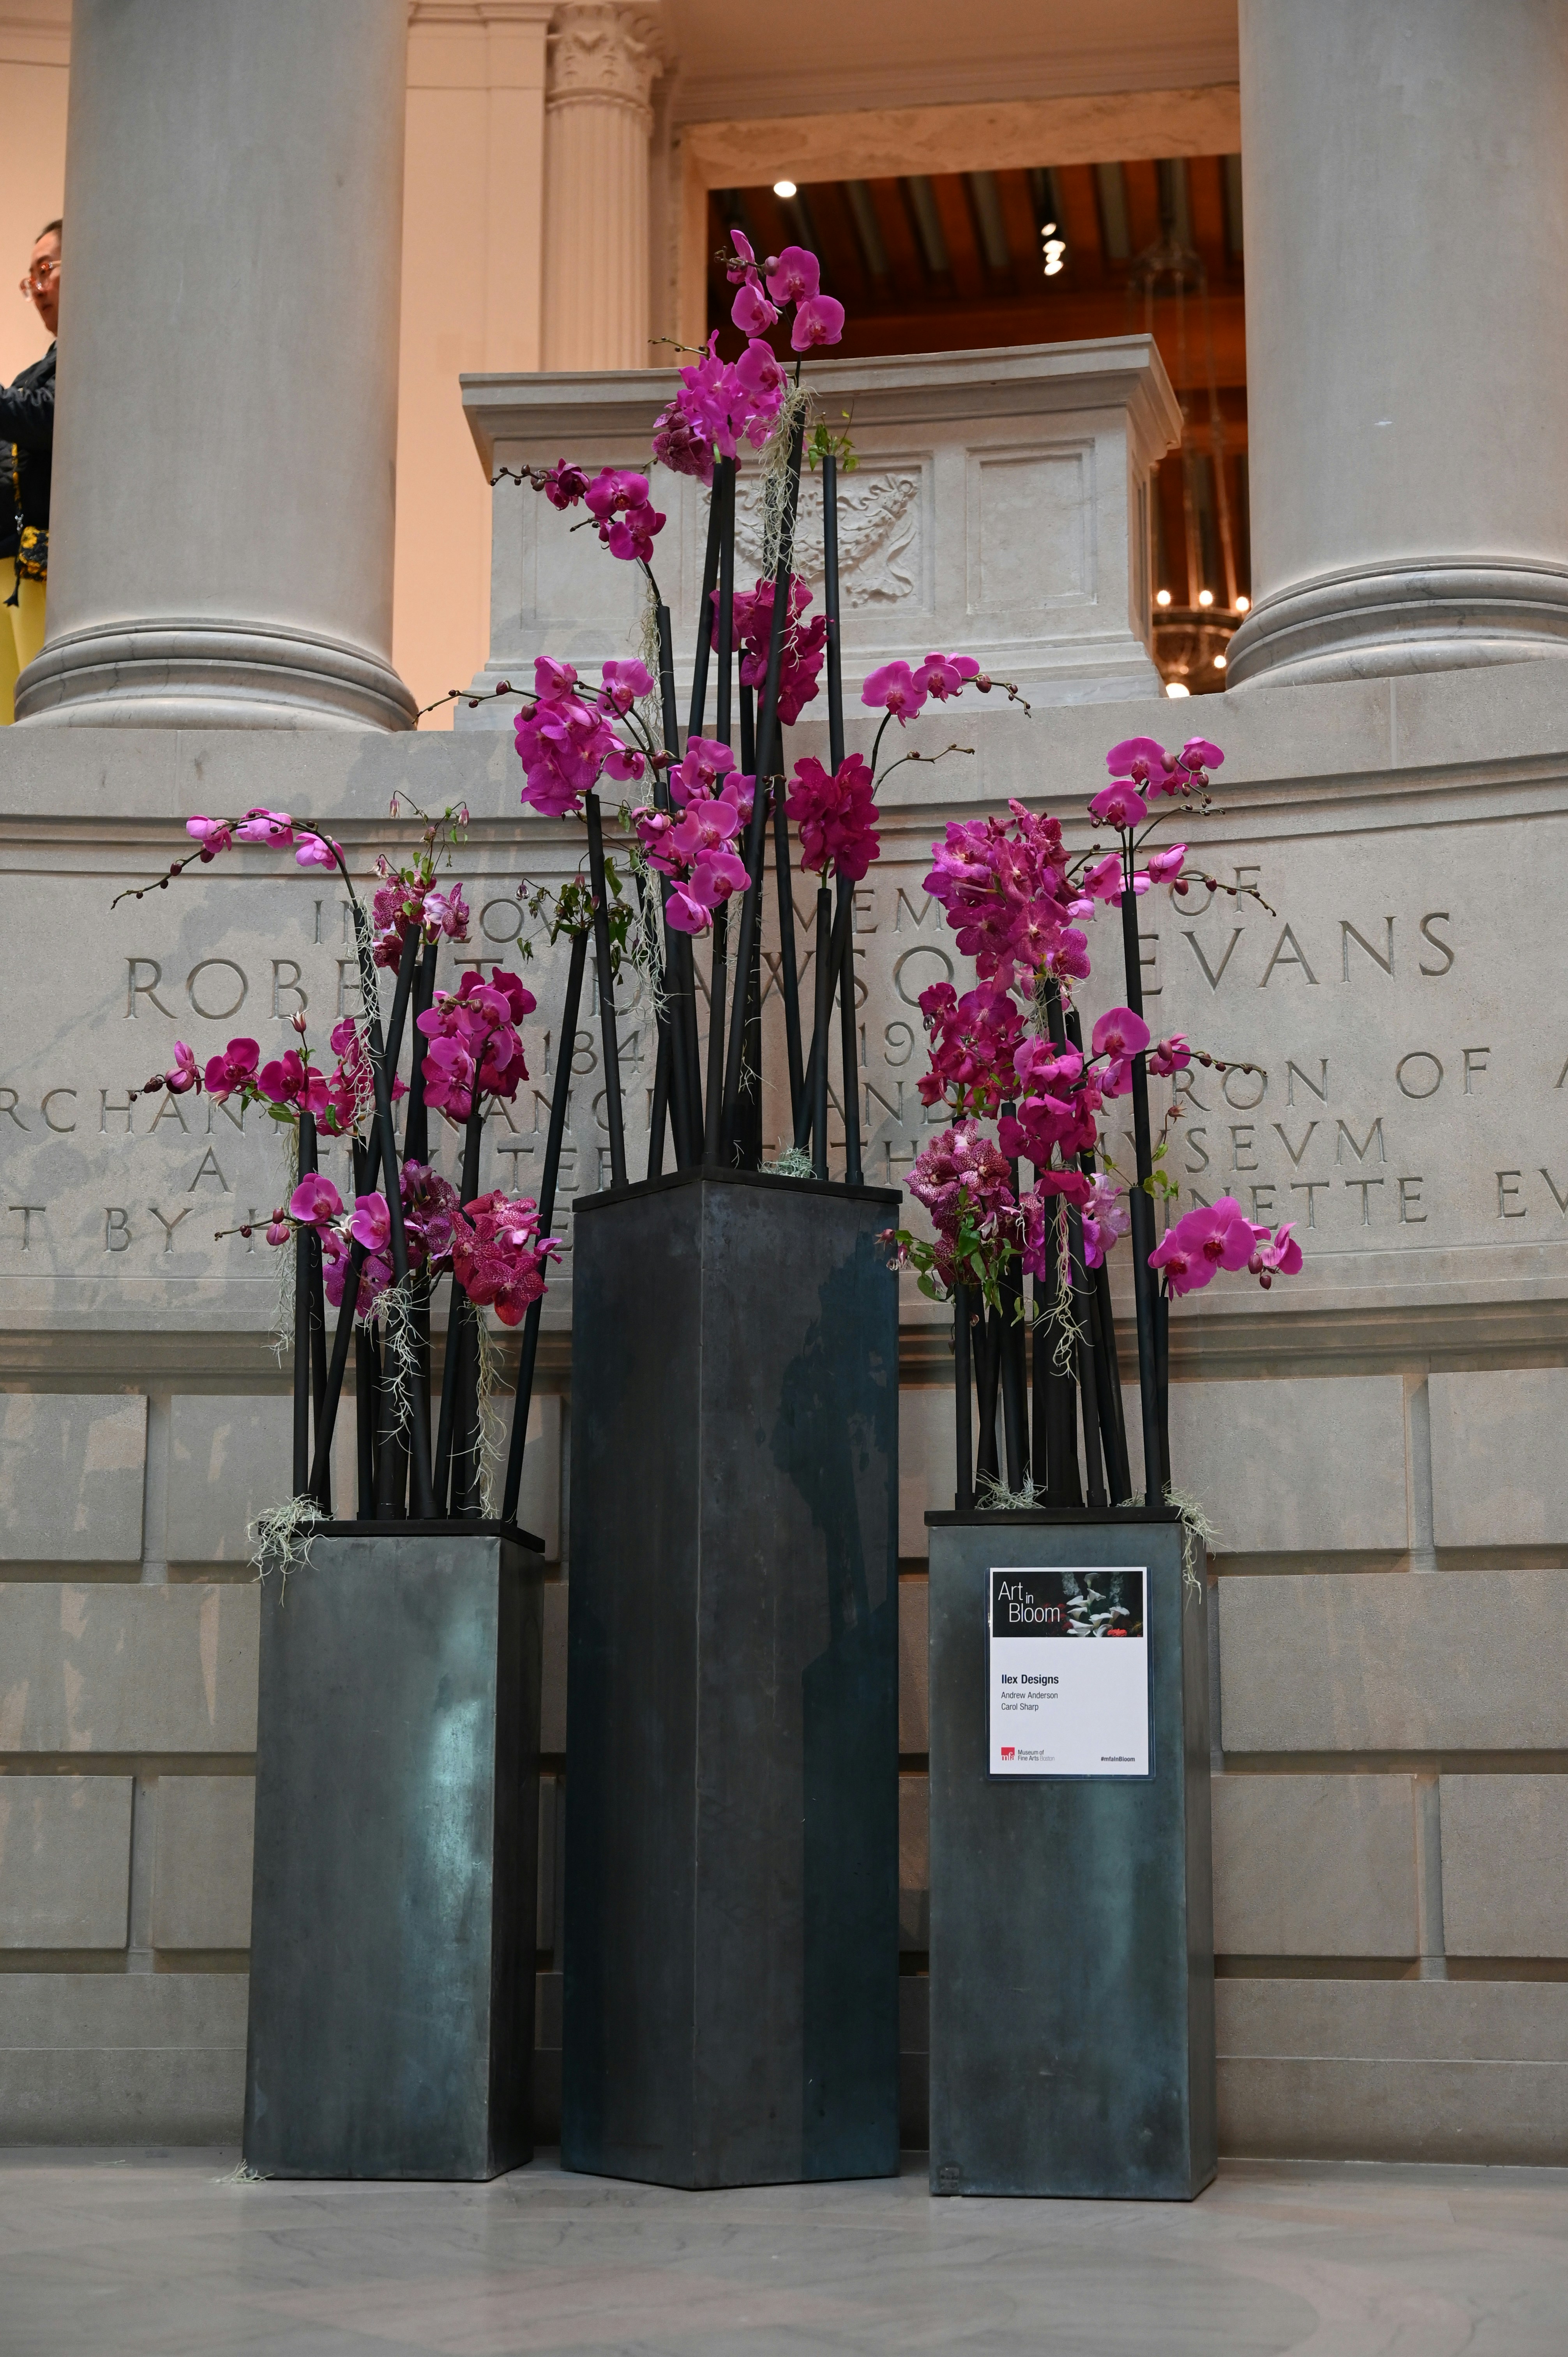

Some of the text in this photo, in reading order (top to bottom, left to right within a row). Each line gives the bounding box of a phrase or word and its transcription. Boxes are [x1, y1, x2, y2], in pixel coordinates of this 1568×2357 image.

[1169, 866, 1261, 917] OF
[124, 957, 504, 1020] ROBET
[0, 1087, 284, 1136] RCHAN
[1395, 1047, 1491, 1099] OF
[185, 1146, 234, 1194] A
[102, 1208, 195, 1254] BY
[998, 1581, 1034, 1604] Art in
[1009, 1603, 1060, 1623] Bloom
[1001, 1674, 1059, 1686] Ilex Designs
[1020, 1703, 1039, 1712] Sharp
